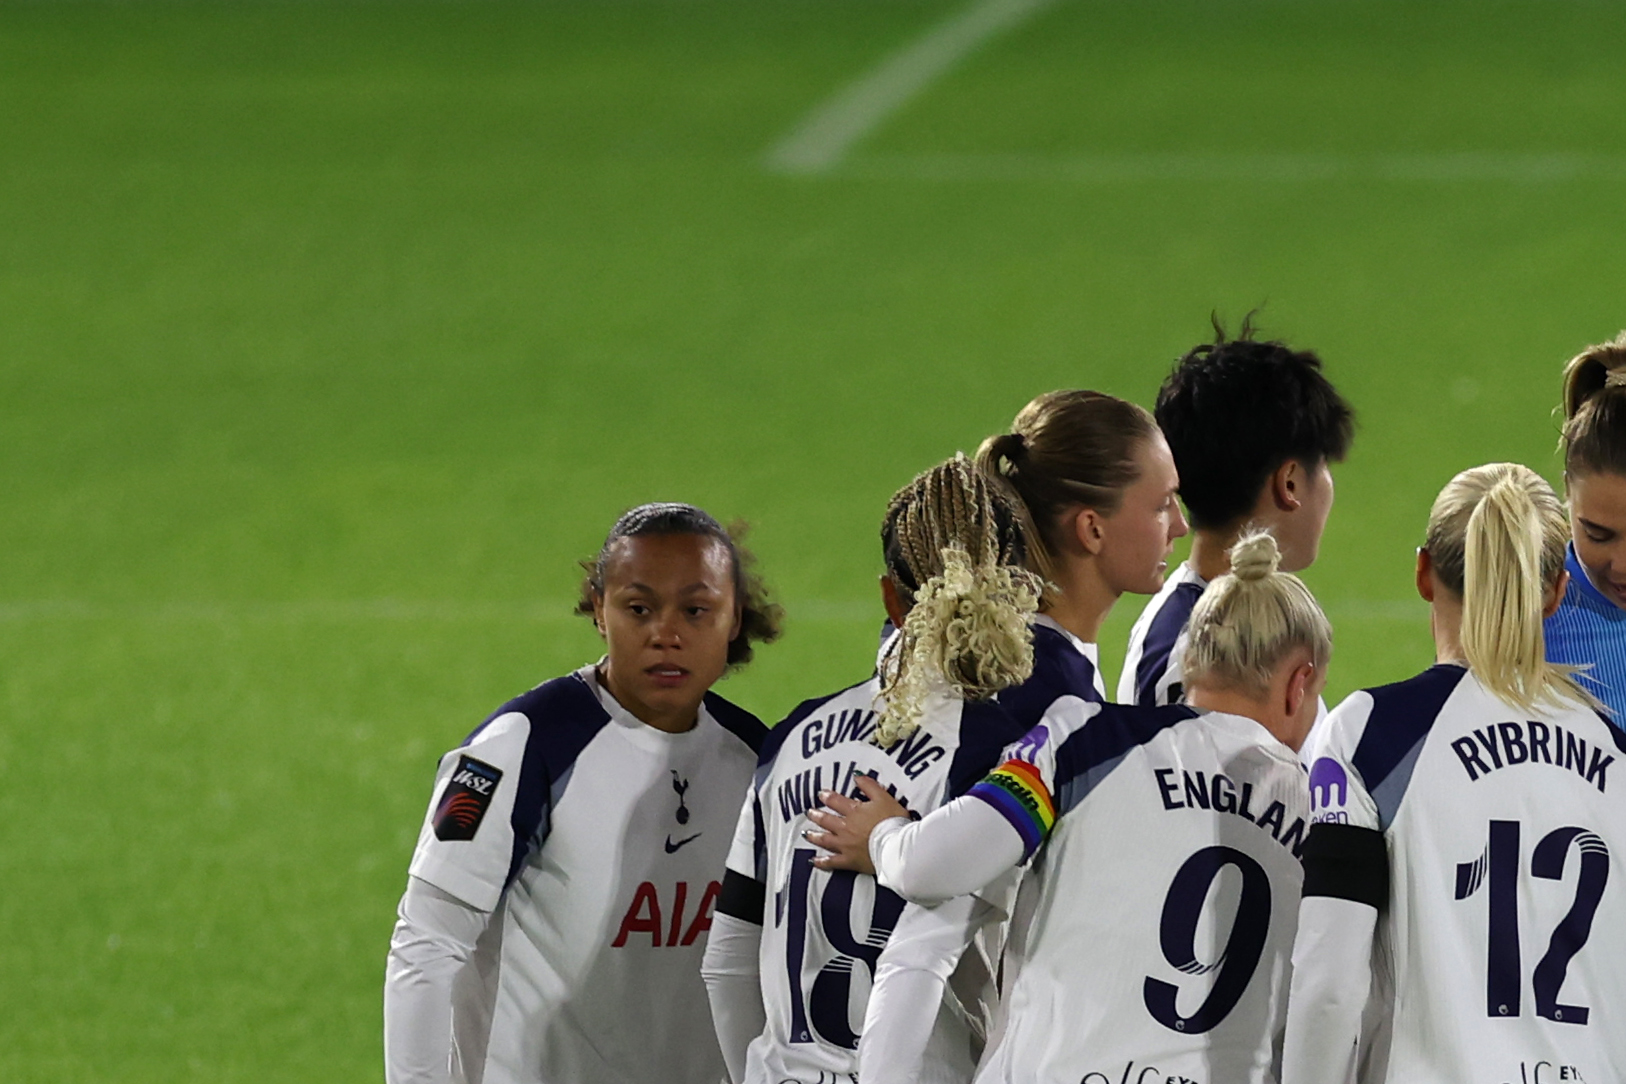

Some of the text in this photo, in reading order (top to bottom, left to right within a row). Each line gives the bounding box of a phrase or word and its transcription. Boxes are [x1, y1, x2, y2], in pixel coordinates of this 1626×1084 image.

[453, 770, 493, 796] WSL
[802, 709, 945, 781] GUNNG
[1451, 720, 1615, 793] RYBRINK
[1154, 768, 1306, 860] ENGLAN
[775, 848, 907, 1050] 18
[1143, 845, 1272, 1035] 9
[1455, 820, 1609, 1024] 12
